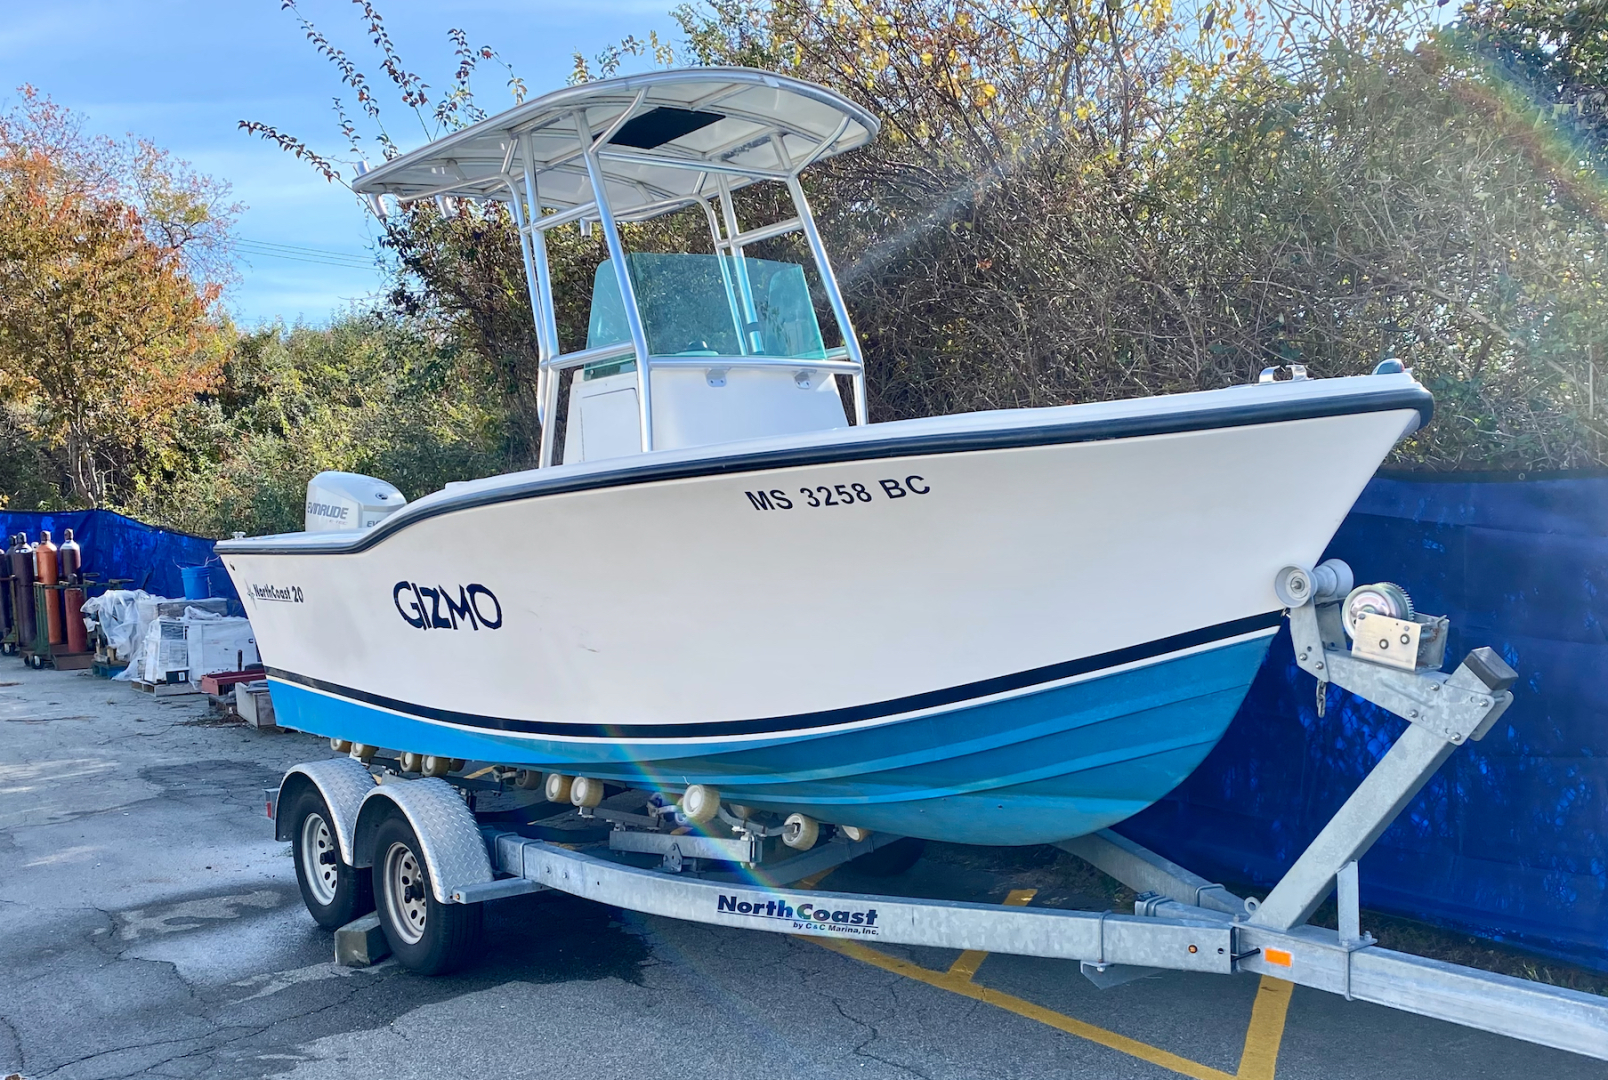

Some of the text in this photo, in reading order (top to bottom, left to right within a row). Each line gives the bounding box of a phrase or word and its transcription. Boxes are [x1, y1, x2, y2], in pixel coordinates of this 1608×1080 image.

[744, 474, 930, 511] MS 3258 BC
[307, 501, 349, 519] EVINRUDE
[292, 585, 304, 603] 20
[393, 580, 502, 630] GIZMO
[793, 922, 803, 930] by
